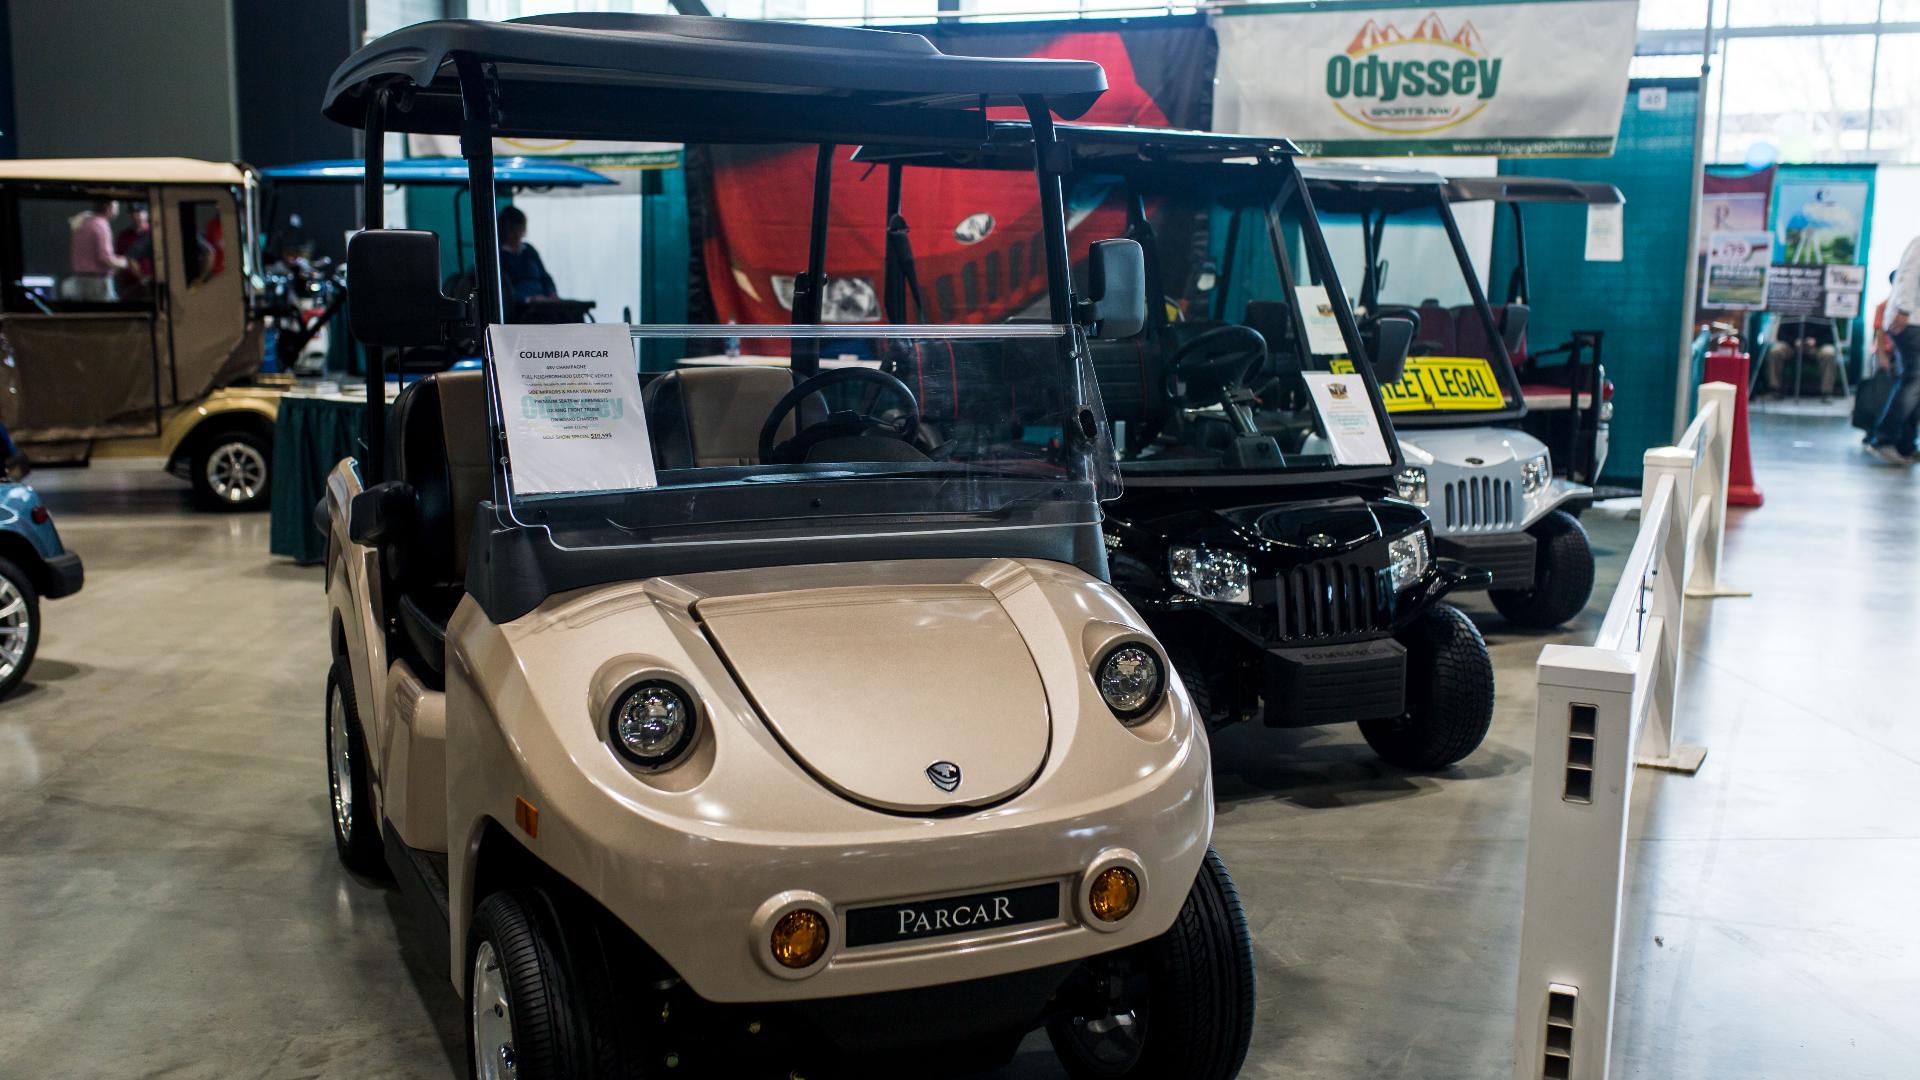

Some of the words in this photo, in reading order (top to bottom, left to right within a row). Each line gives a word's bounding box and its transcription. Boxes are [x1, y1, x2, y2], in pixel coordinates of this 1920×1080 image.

[1326, 54, 1502, 101] Odyssey
[1371, 107, 1424, 116] SPORTS
[1427, 107, 1449, 115] NW
[519, 350, 570, 359] COLUMBIA
[572, 350, 609, 358] PARCAR
[1428, 367, 1496, 398] LEGAL
